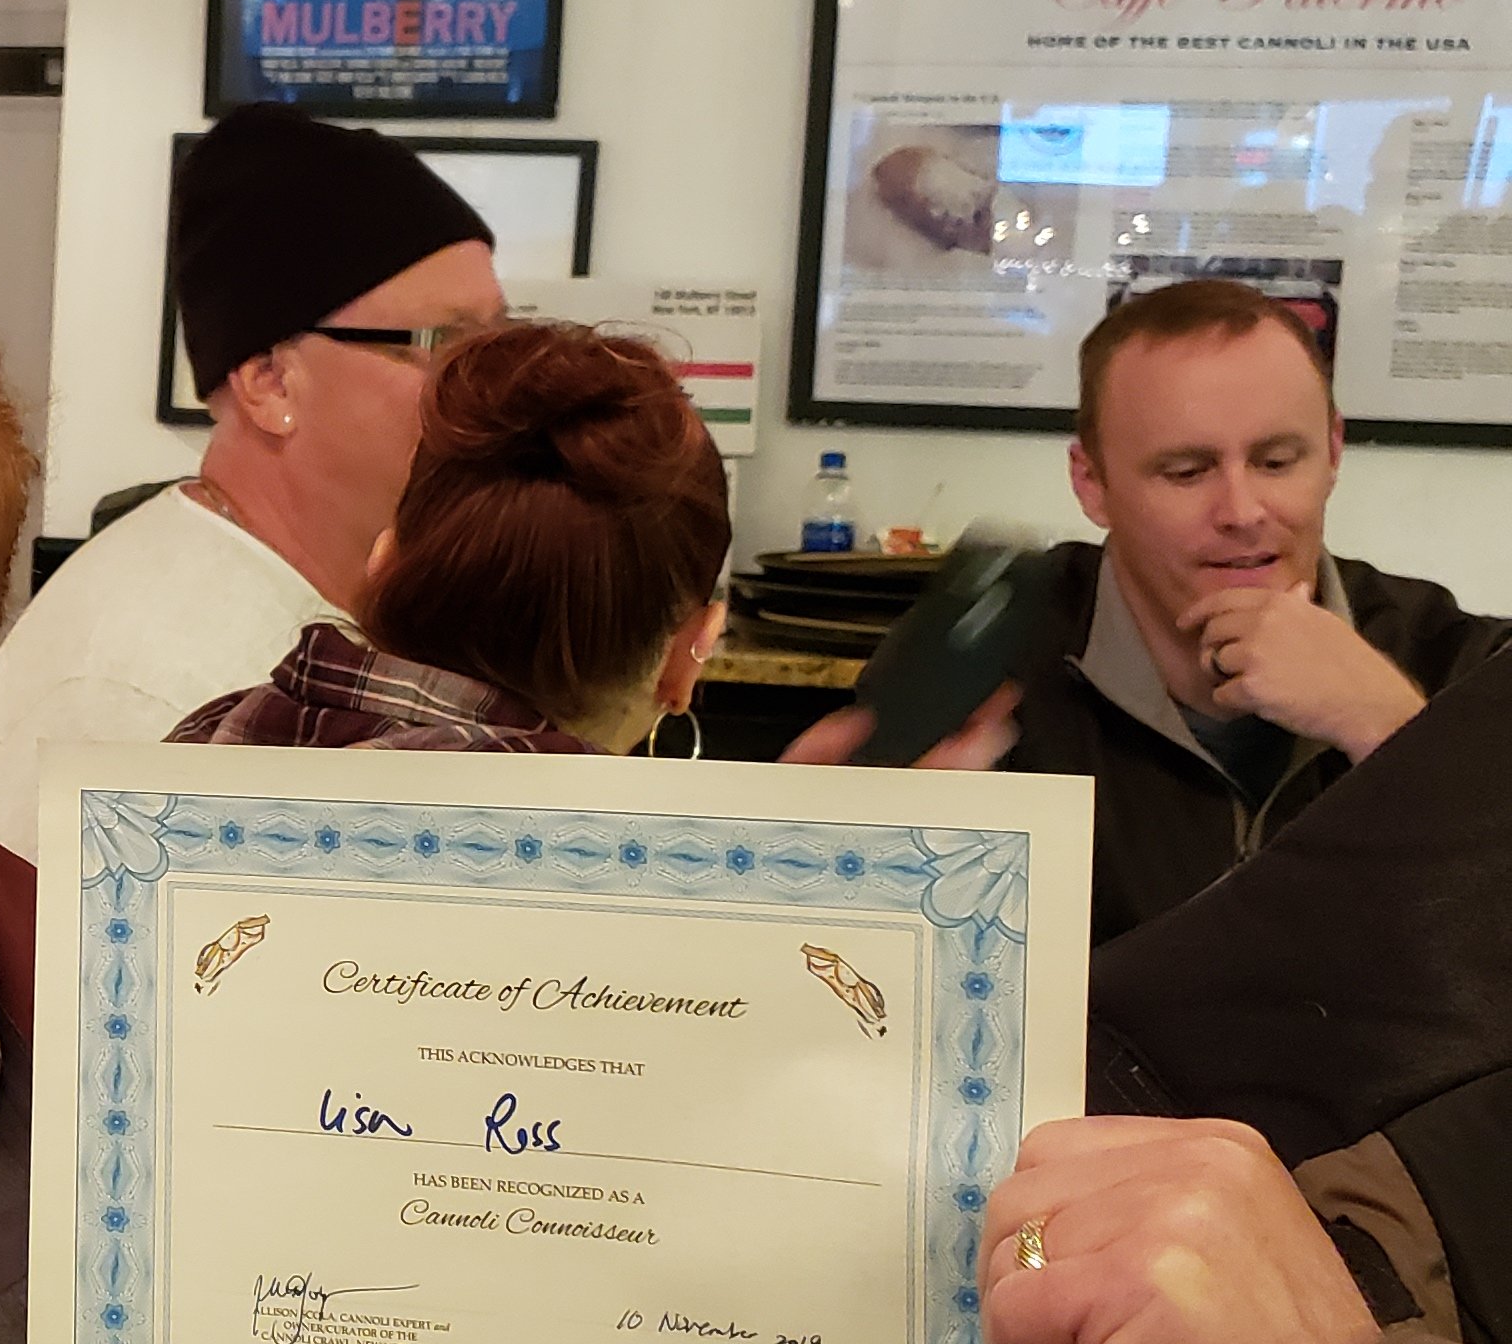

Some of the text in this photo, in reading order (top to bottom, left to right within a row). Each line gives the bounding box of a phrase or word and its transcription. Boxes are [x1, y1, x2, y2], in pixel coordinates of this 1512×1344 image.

[261, 0, 517, 45] MULBERRY
[1026, 35, 1471, 53] HOME OF THE BEST CANNOLI IN THE USA
[322, 960, 750, 1019] Certificate of Achievement
[417, 1046, 646, 1077] THIS ACKNOWLEDGES THAT
[484, 1092, 564, 1156] Ross
[413, 1172, 646, 1206] HAS BEEN RECOGNIZED AS A
[399, 1198, 661, 1246] Cannoli Connoisseur
[299, 1309, 338, 1323] COLA
[393, 1317, 432, 1331] EXPERT
[616, 1308, 644, 1330] 10
[379, 1329, 393, 1340] OF
[394, 1330, 418, 1342] THE
